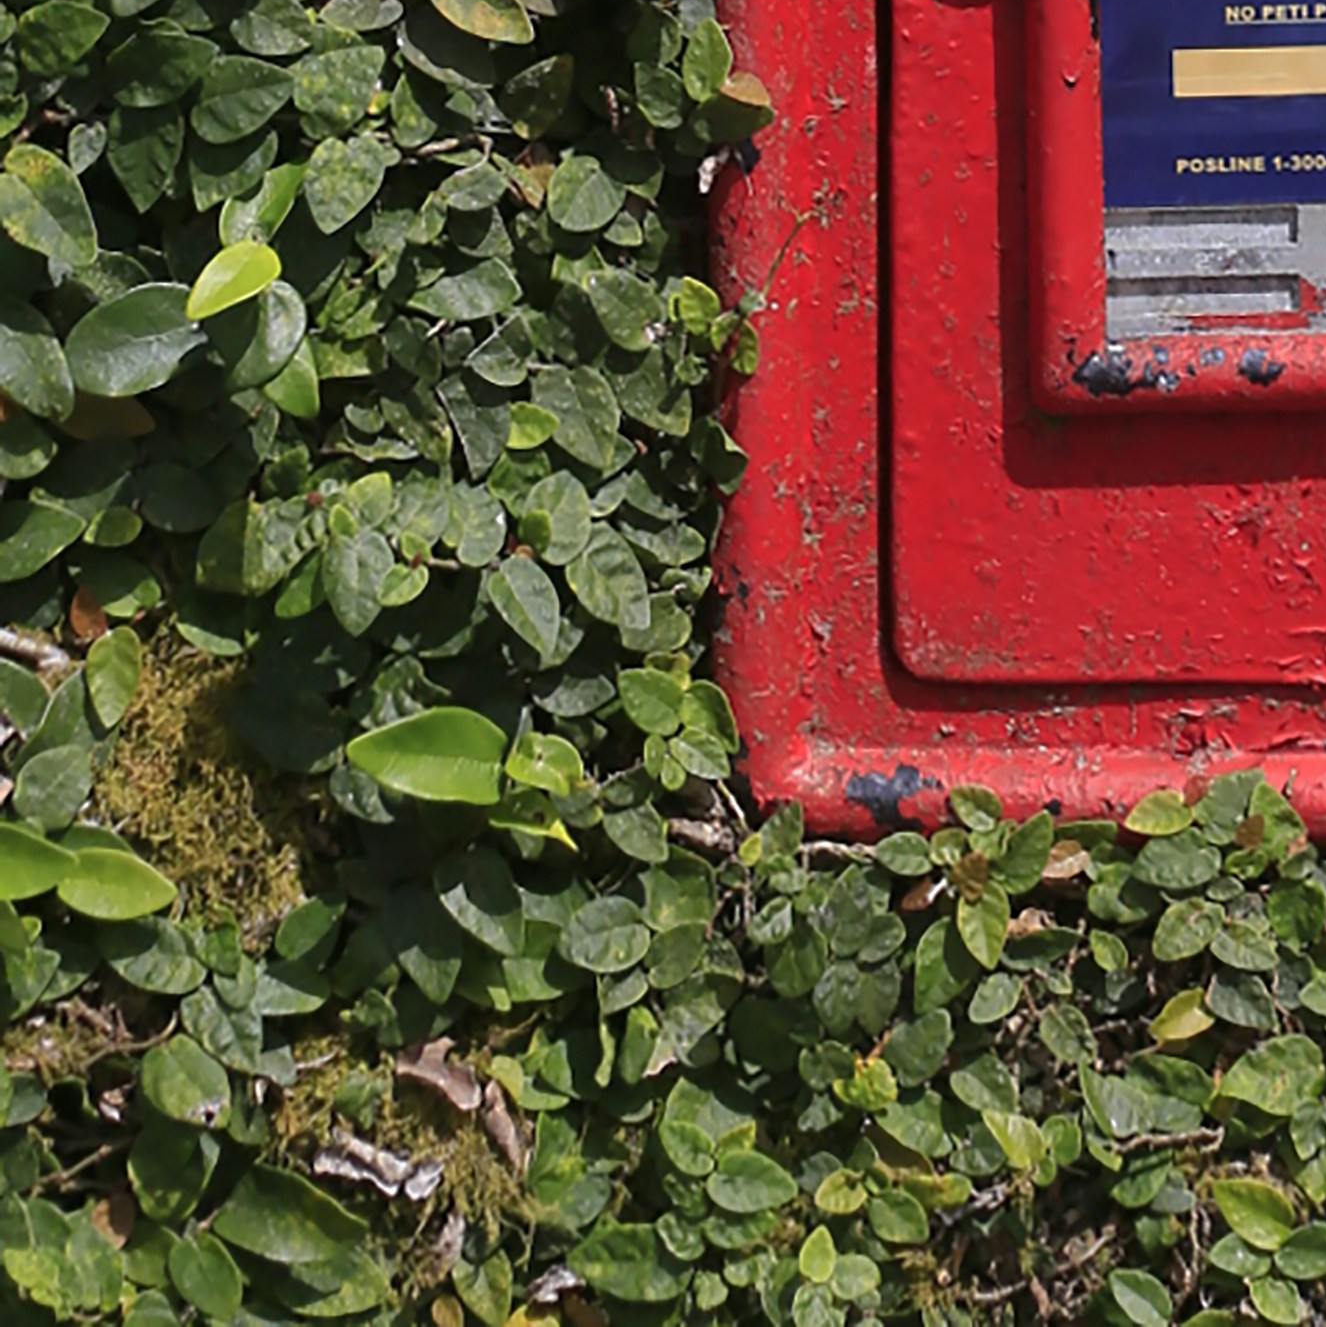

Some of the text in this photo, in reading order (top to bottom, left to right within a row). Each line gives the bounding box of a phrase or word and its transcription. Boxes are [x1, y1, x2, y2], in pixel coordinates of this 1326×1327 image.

[1225, 6, 1257, 22] NO
[1262, 4, 1308, 21] PETI
[1176, 156, 1266, 174] POSLINE
